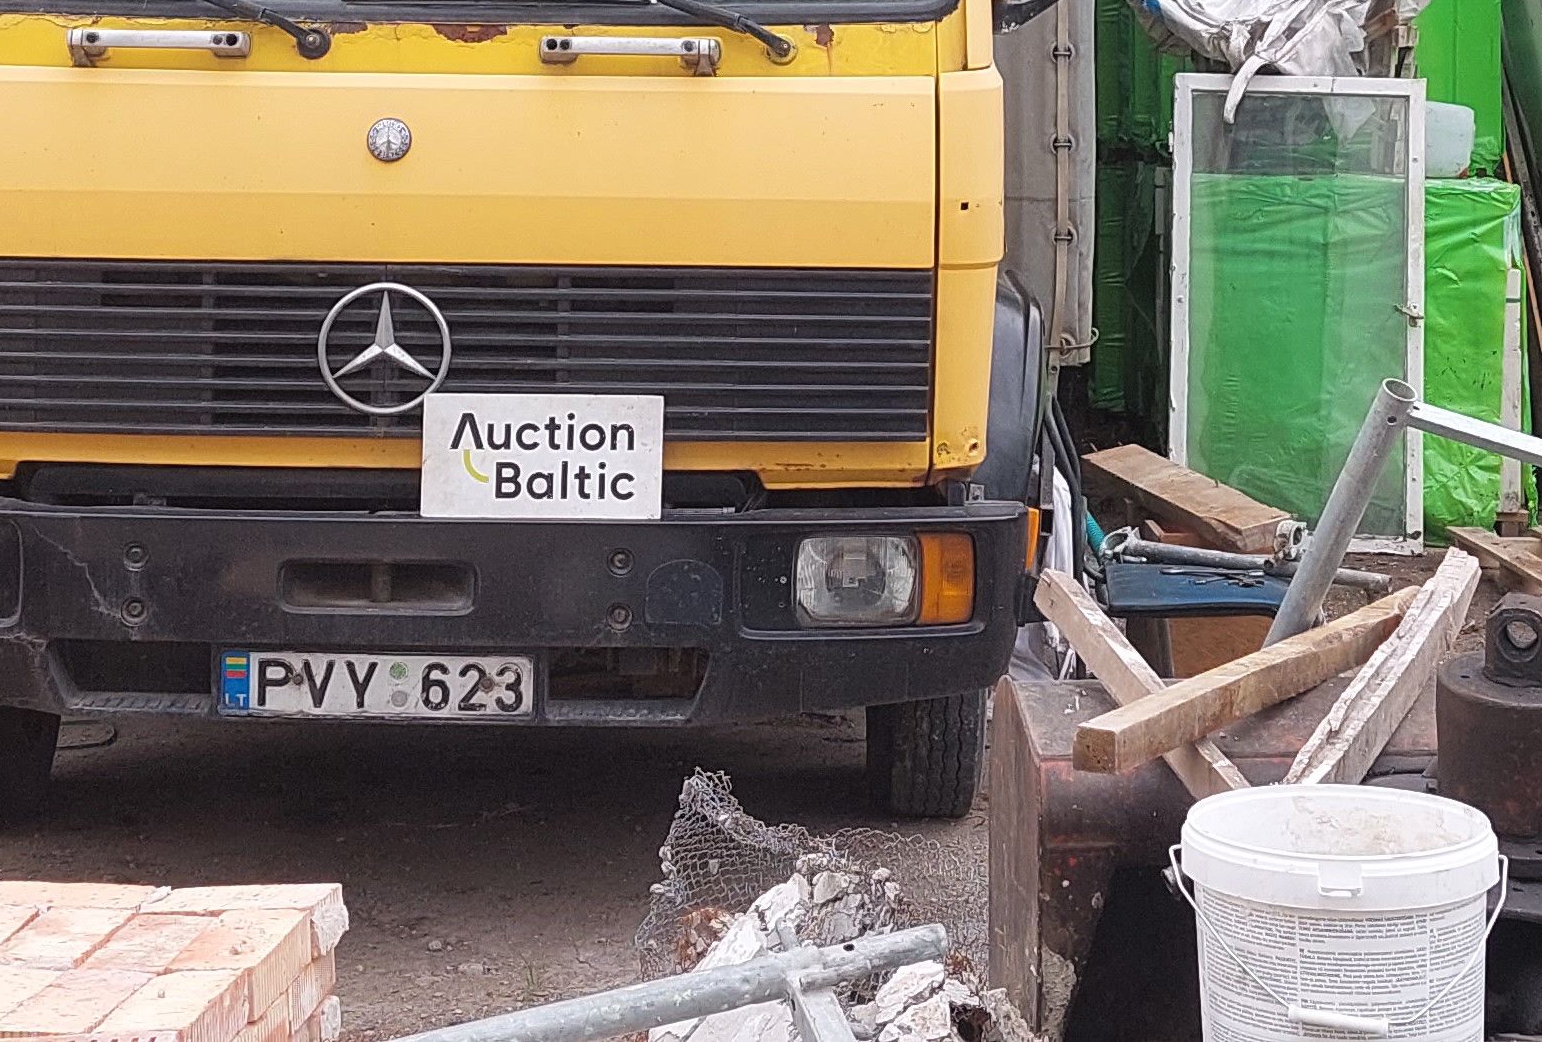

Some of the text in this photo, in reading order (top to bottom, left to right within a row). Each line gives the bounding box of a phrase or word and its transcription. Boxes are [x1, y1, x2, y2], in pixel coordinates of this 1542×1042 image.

[449, 412, 636, 452] Auction
[495, 460, 635, 500] Baltic
[224, 658, 524, 712] LT PVY 623
